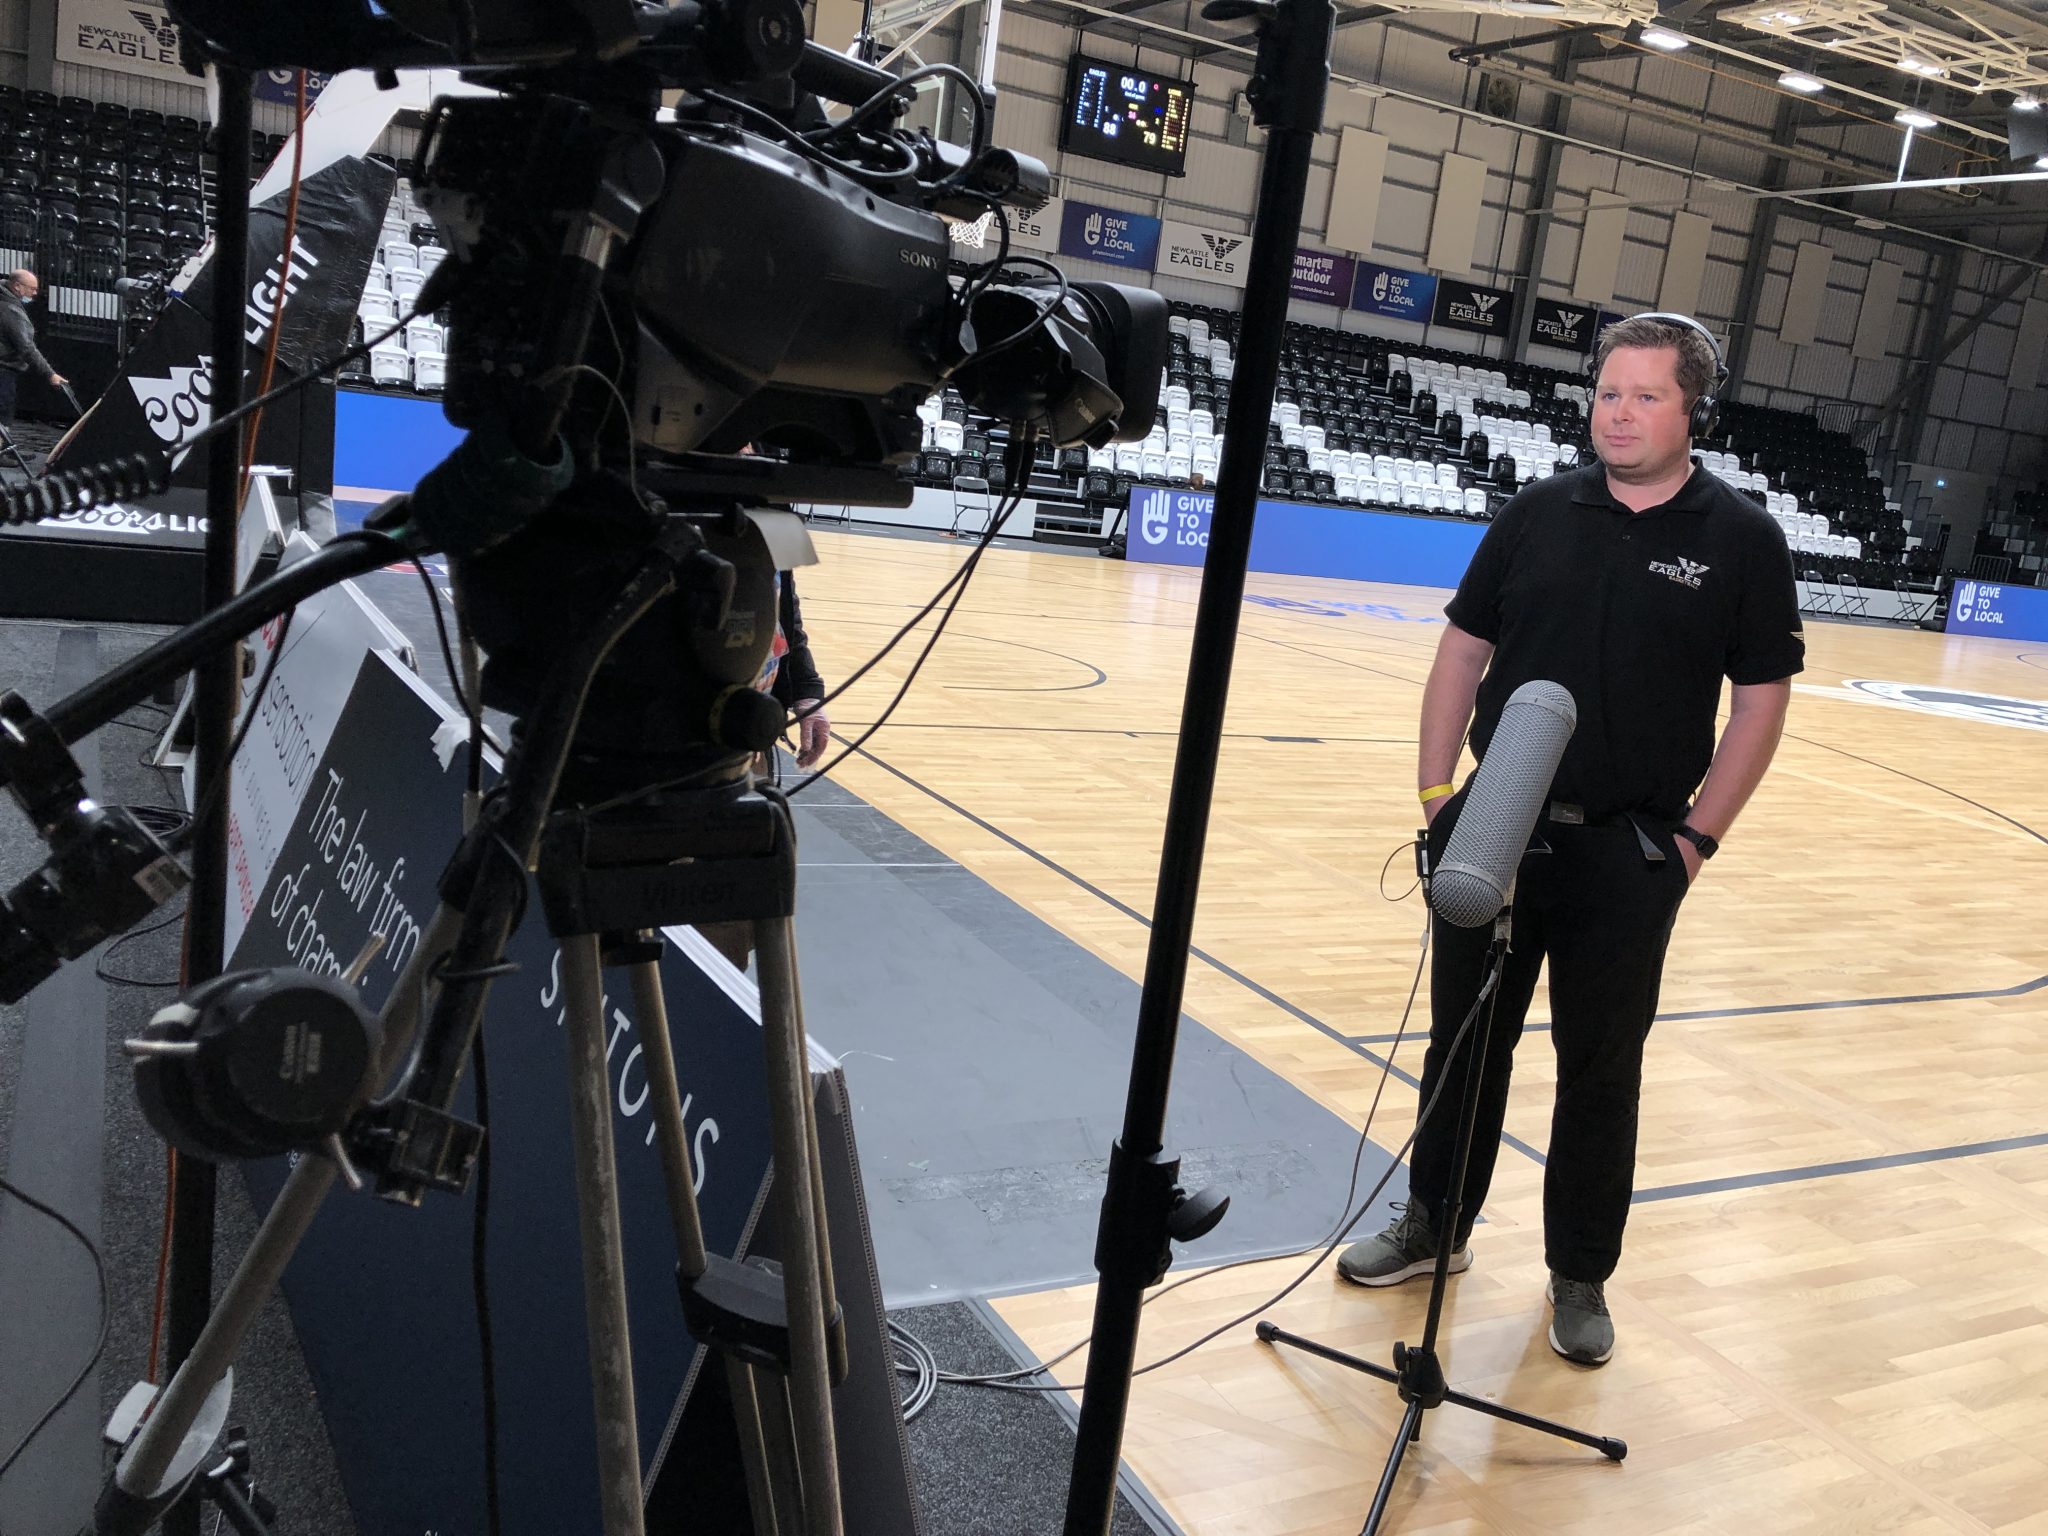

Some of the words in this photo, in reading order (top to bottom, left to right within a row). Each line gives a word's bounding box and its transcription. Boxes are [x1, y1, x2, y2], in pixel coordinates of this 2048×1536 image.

[78, 24, 146, 44] NEWCASTLE
[77, 33, 176, 65] EAGLE
[1103, 122, 1117, 136] 88
[1143, 131, 1157, 145] 79
[1105, 217, 1128, 231] GIVE
[1104, 227, 1119, 238] TO
[1103, 238, 1136, 252] LOCAL
[1171, 245, 1209, 258] NEWCASTLE
[899, 249, 940, 270] SONY
[1170, 252, 1235, 274] EAGLES
[1390, 276, 1410, 288] GIVE
[1390, 285, 1402, 295] TO
[1388, 293, 1415, 307] LOCAL
[1450, 302, 1476, 311] NEWCASTLE
[1449, 306, 1494, 323] EAGLES
[1538, 318, 1562, 328] NEWCASTLE
[1536, 323, 1578, 339] EAGLES
[1177, 496, 1214, 514] GIVE
[1176, 513, 1200, 529] TO
[1176, 530, 1209, 547] LOC
[1650, 560, 1682, 571] NEWCASTLE
[1648, 564, 1702, 586] EAGLES
[1979, 585, 2001, 599] GIVE
[1977, 598, 1991, 610] TO
[1974, 610, 2004, 624] LOCAL
[308, 767, 346, 864] The
[336, 808, 380, 913] law
[368, 856, 421, 972] firm
[270, 863, 311, 928] of
